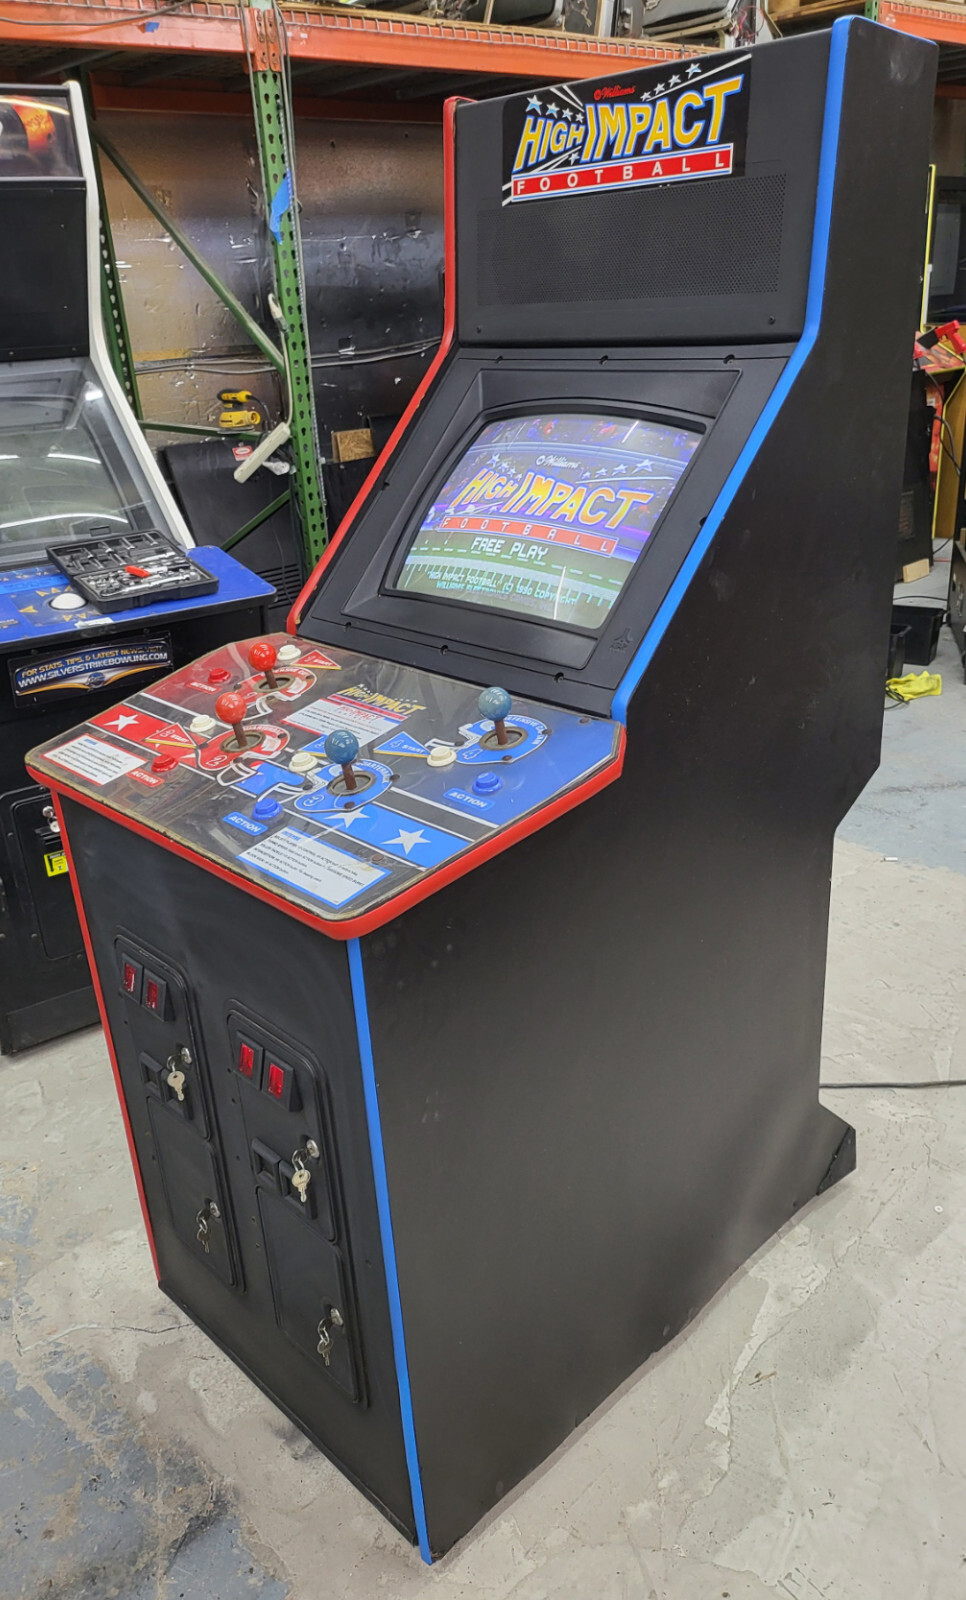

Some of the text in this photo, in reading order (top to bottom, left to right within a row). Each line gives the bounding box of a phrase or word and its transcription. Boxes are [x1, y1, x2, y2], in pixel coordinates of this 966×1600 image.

[601, 85, 637, 98] Williams
[513, 74, 744, 174] HIGH IMPACT
[516, 153, 725, 194] FOOTBALL
[450, 468, 654, 530] HIGH IMPACT
[441, 517, 609, 553] FOOTBALL
[471, 537, 549, 560] FREE PLAY
[22, 668, 37, 679] FOR
[93, 650, 119, 659] LATEST
[362, 692, 427, 715] IMPACT
[130, 770, 159, 784] ACTION
[450, 791, 488, 808] ACTION
[228, 816, 261, 832] ACTION
